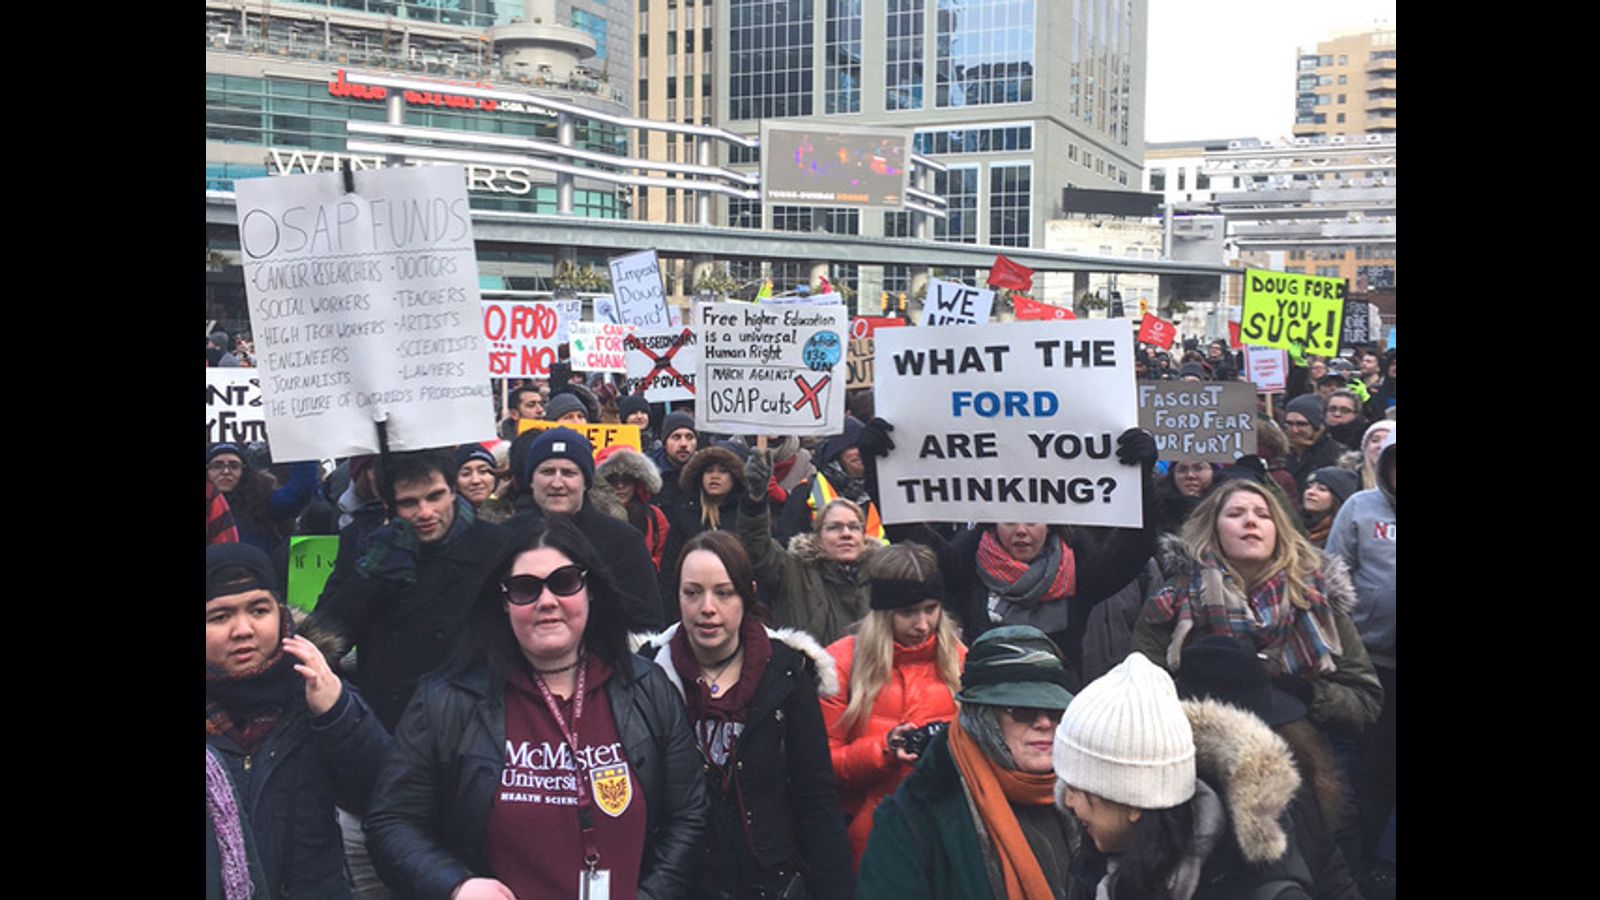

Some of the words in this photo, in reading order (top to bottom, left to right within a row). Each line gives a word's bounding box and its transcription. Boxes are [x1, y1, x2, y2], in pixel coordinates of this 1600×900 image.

[242, 202, 359, 259] OSAP
[370, 197, 468, 251] FUNDS
[255, 262, 309, 292] CANCER
[395, 254, 457, 280] DOCTORS
[395, 286, 466, 308] TEACHERS
[1252, 275, 1298, 295] DOUG
[1304, 279, 1345, 300] FORD
[259, 297, 304, 320] SOCIAL
[311, 294, 370, 313] WORKERS
[937, 284, 979, 317] WE
[1276, 299, 1312, 319] YOU
[399, 311, 460, 332] ARTISTS
[510, 303, 558, 340] FORD
[703, 306, 738, 327] Free
[744, 308, 779, 332] higher
[783, 309, 836, 327] Education
[1243, 310, 1336, 349] SUCK!
[264, 326, 299, 346] HIGH
[705, 330, 717, 343] is
[722, 333, 732, 342] a
[739, 328, 797, 344] universal
[268, 347, 350, 371] ENGINEERS
[705, 345, 746, 359] Human
[749, 344, 782, 364] Right
[893, 345, 1010, 376] WHAT
[1035, 340, 1116, 368] THE
[270, 371, 351, 394] JOURNALISTS
[749, 368, 795, 381] AGAINST
[337, 390, 352, 408] OF
[711, 386, 760, 414] OSAP
[761, 391, 792, 415] cuts
[952, 390, 1059, 418] FORD
[1139, 385, 1223, 408] FASCIST
[1155, 409, 1200, 428] FORD
[1203, 410, 1252, 430] FEAR
[919, 432, 998, 458] ARE
[1028, 433, 1111, 459] YOU
[1153, 434, 1178, 451] UR
[1183, 431, 1244, 460] FURY!
[897, 477, 1117, 504] THINKING?
[501, 768, 577, 791] Universi
[501, 792, 541, 803] HEALTH
